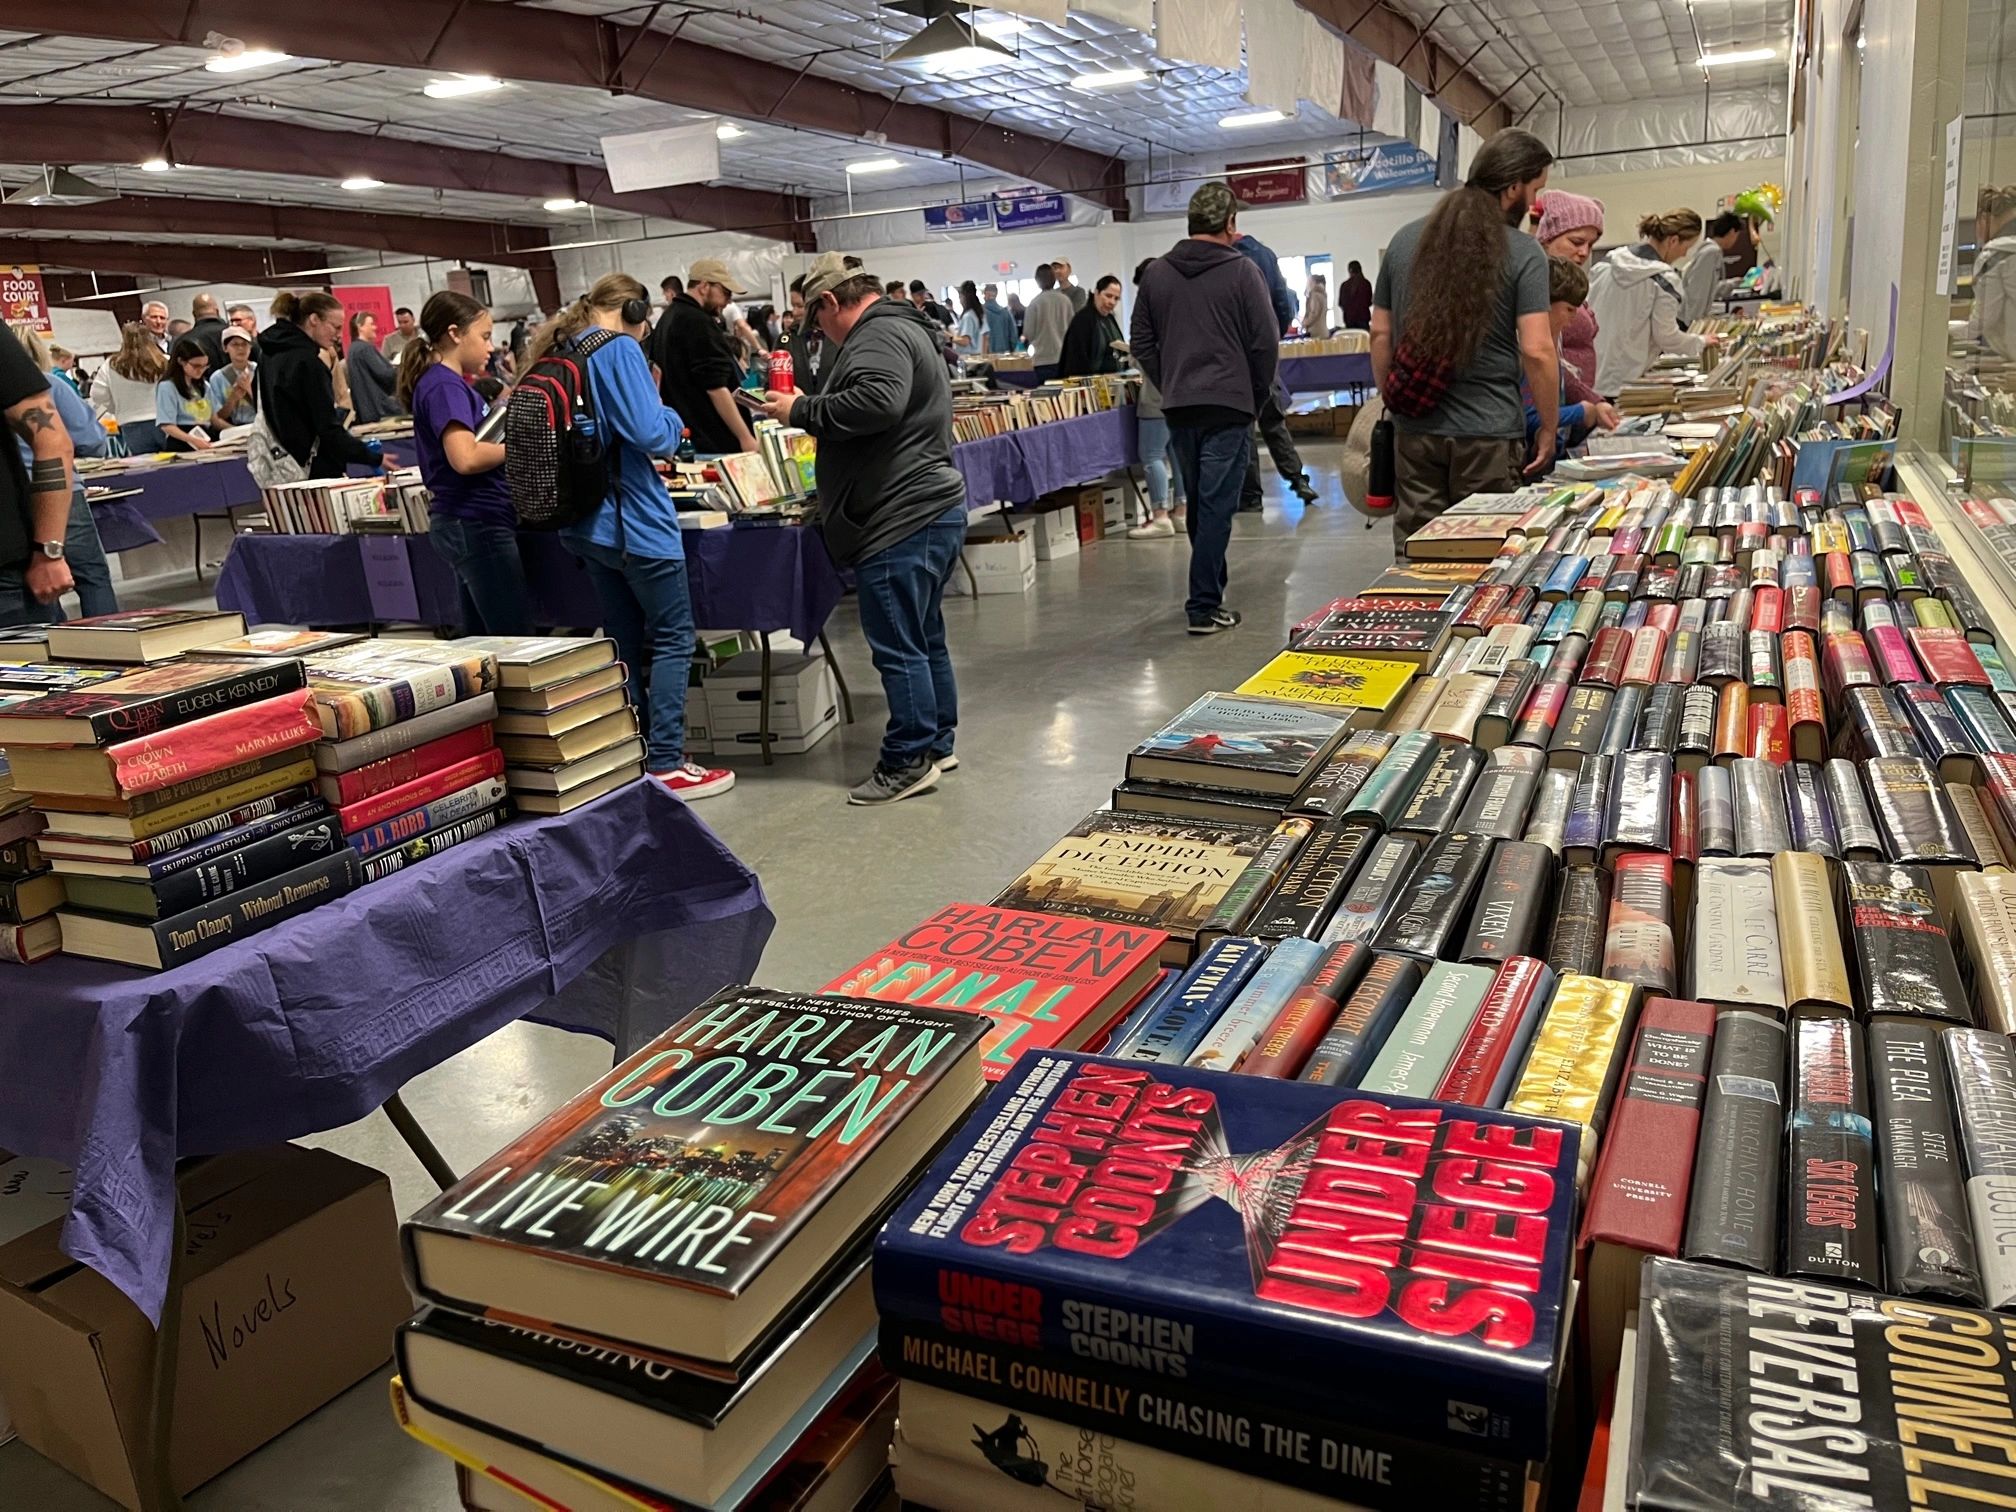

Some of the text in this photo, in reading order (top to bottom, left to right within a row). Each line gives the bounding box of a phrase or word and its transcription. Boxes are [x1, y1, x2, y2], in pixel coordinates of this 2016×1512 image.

[1019, 199, 1059, 212] Elementary
[3, 280, 36, 291] FOOD
[3, 291, 40, 302] COURT
[1285, 653, 1408, 669] PRELUDE TO
[109, 701, 165, 731] QUEEN
[177, 673, 282, 716] EUGENE KENNEDY
[135, 715, 162, 733] BEE
[235, 725, 306, 755] MARY M. LUKE
[127, 745, 174, 769] CROWN
[143, 741, 152, 751] A
[127, 761, 188, 788] ELIZABETH
[154, 760, 263, 804] The Portuguese Escape
[1309, 763, 1347, 789] STONE
[1342, 764, 1370, 789] SIEGE
[239, 796, 277, 821] THE FRONT
[269, 803, 325, 832] JOHN GRISHAM
[432, 786, 479, 814] CELEBRITY
[448, 800, 478, 818] DEATH
[150, 812, 234, 855] PATRICIA CORNWELL
[361, 809, 427, 852] J. D. ROBB
[431, 810, 496, 859] FRANK ROBINSON
[1098, 838, 1216, 861] EMPIRE
[162, 832, 251, 874] SKIPPING CHRISTMAS
[365, 851, 404, 883] WAITING
[1058, 849, 1231, 879] DECEPTION
[1278, 830, 1336, 896] JONATHAN HARR
[1296, 823, 1369, 908] A CIVIL ACTION
[168, 875, 331, 952] Tom Clancy Without Remorse
[931, 907, 1150, 951] HARLAN
[1043, 903, 1151, 923] DEAN JOBB
[1476, 900, 1515, 939] VIXEN
[1977, 893, 2009, 949] CIDER HOUSE
[891, 949, 1041, 978] NEW YORK TIMES BESTSELLING AUTHOR
[898, 924, 1129, 978] COBEN
[1366, 955, 1403, 982] JOHN
[1708, 933, 1726, 973] GARDENER
[1744, 918, 1775, 977] LE CARRÉ
[868, 961, 1077, 1023] FINAL
[1313, 969, 1340, 987] MASS
[736, 997, 954, 1029] BESTSELLING AUTHOR CAUGHT
[806, 998, 911, 1017] NEW YORK TIMES
[1215, 981, 1270, 1050] summer breeze
[1260, 997, 1317, 1058] WHITLEY STRIEBER
[1333, 979, 1388, 1036] LESCROART
[1393, 971, 1470, 1087] Second Honeymoon James
[675, 1003, 956, 1077] HARLAN
[1648, 1042, 1696, 1054] WHAT IS
[1652, 1050, 1669, 1058] TO
[1309, 1060, 1329, 1081] THE
[1649, 1057, 1690, 1068] DONE?
[1886, 1040, 1933, 1102] THE PLEA
[599, 1048, 910, 1146] COBEN
[1543, 1058, 1576, 1114] ELIZABETH
[909, 1212, 935, 1236] NEW
[931, 1181, 960, 1215] YORK
[954, 1149, 985, 1186] TIMES
[973, 1099, 1027, 1153] BESTSELLING
[1015, 1063, 1051, 1105] AUTHOR
[928, 1059, 1074, 1239] FLIGHT THE INTRUDER AND THE MINOTAUR
[960, 1062, 1152, 1255] STEPHEN
[1889, 1118, 1918, 1169] CAVANAGH
[1921, 1131, 1949, 1163] STEVE
[1052, 1082, 1217, 1260] COONTS
[1613, 1183, 1673, 1198] UNIVERSITY
[1620, 1177, 1667, 1190] CORNELL
[1733, 1108, 1762, 1232] MARCHING HOME
[1255, 1099, 1444, 1319] UNDER
[1626, 1192, 1656, 1202] PRESS
[1806, 1180, 1859, 1230] YEARS
[441, 1166, 777, 1275] LIVE WIRE
[1398, 1119, 1566, 1350] SIEGE
[1808, 1255, 1860, 1269] DUTTON
[937, 1269, 1043, 1324] UNDER
[199, 1272, 298, 1371] Novels
[940, 1305, 1043, 1350] SIEGE
[1061, 1299, 1195, 1356] STEPHEN
[1069, 1332, 1188, 1379] COONTS
[903, 1335, 1394, 1487] MICHAEL CONNELLY CHASING THE DIME
[1746, 1275, 1875, 1509] REVERSAL
[1055, 1450, 1073, 1485] The
[1074, 1426, 1096, 1490] Horse
